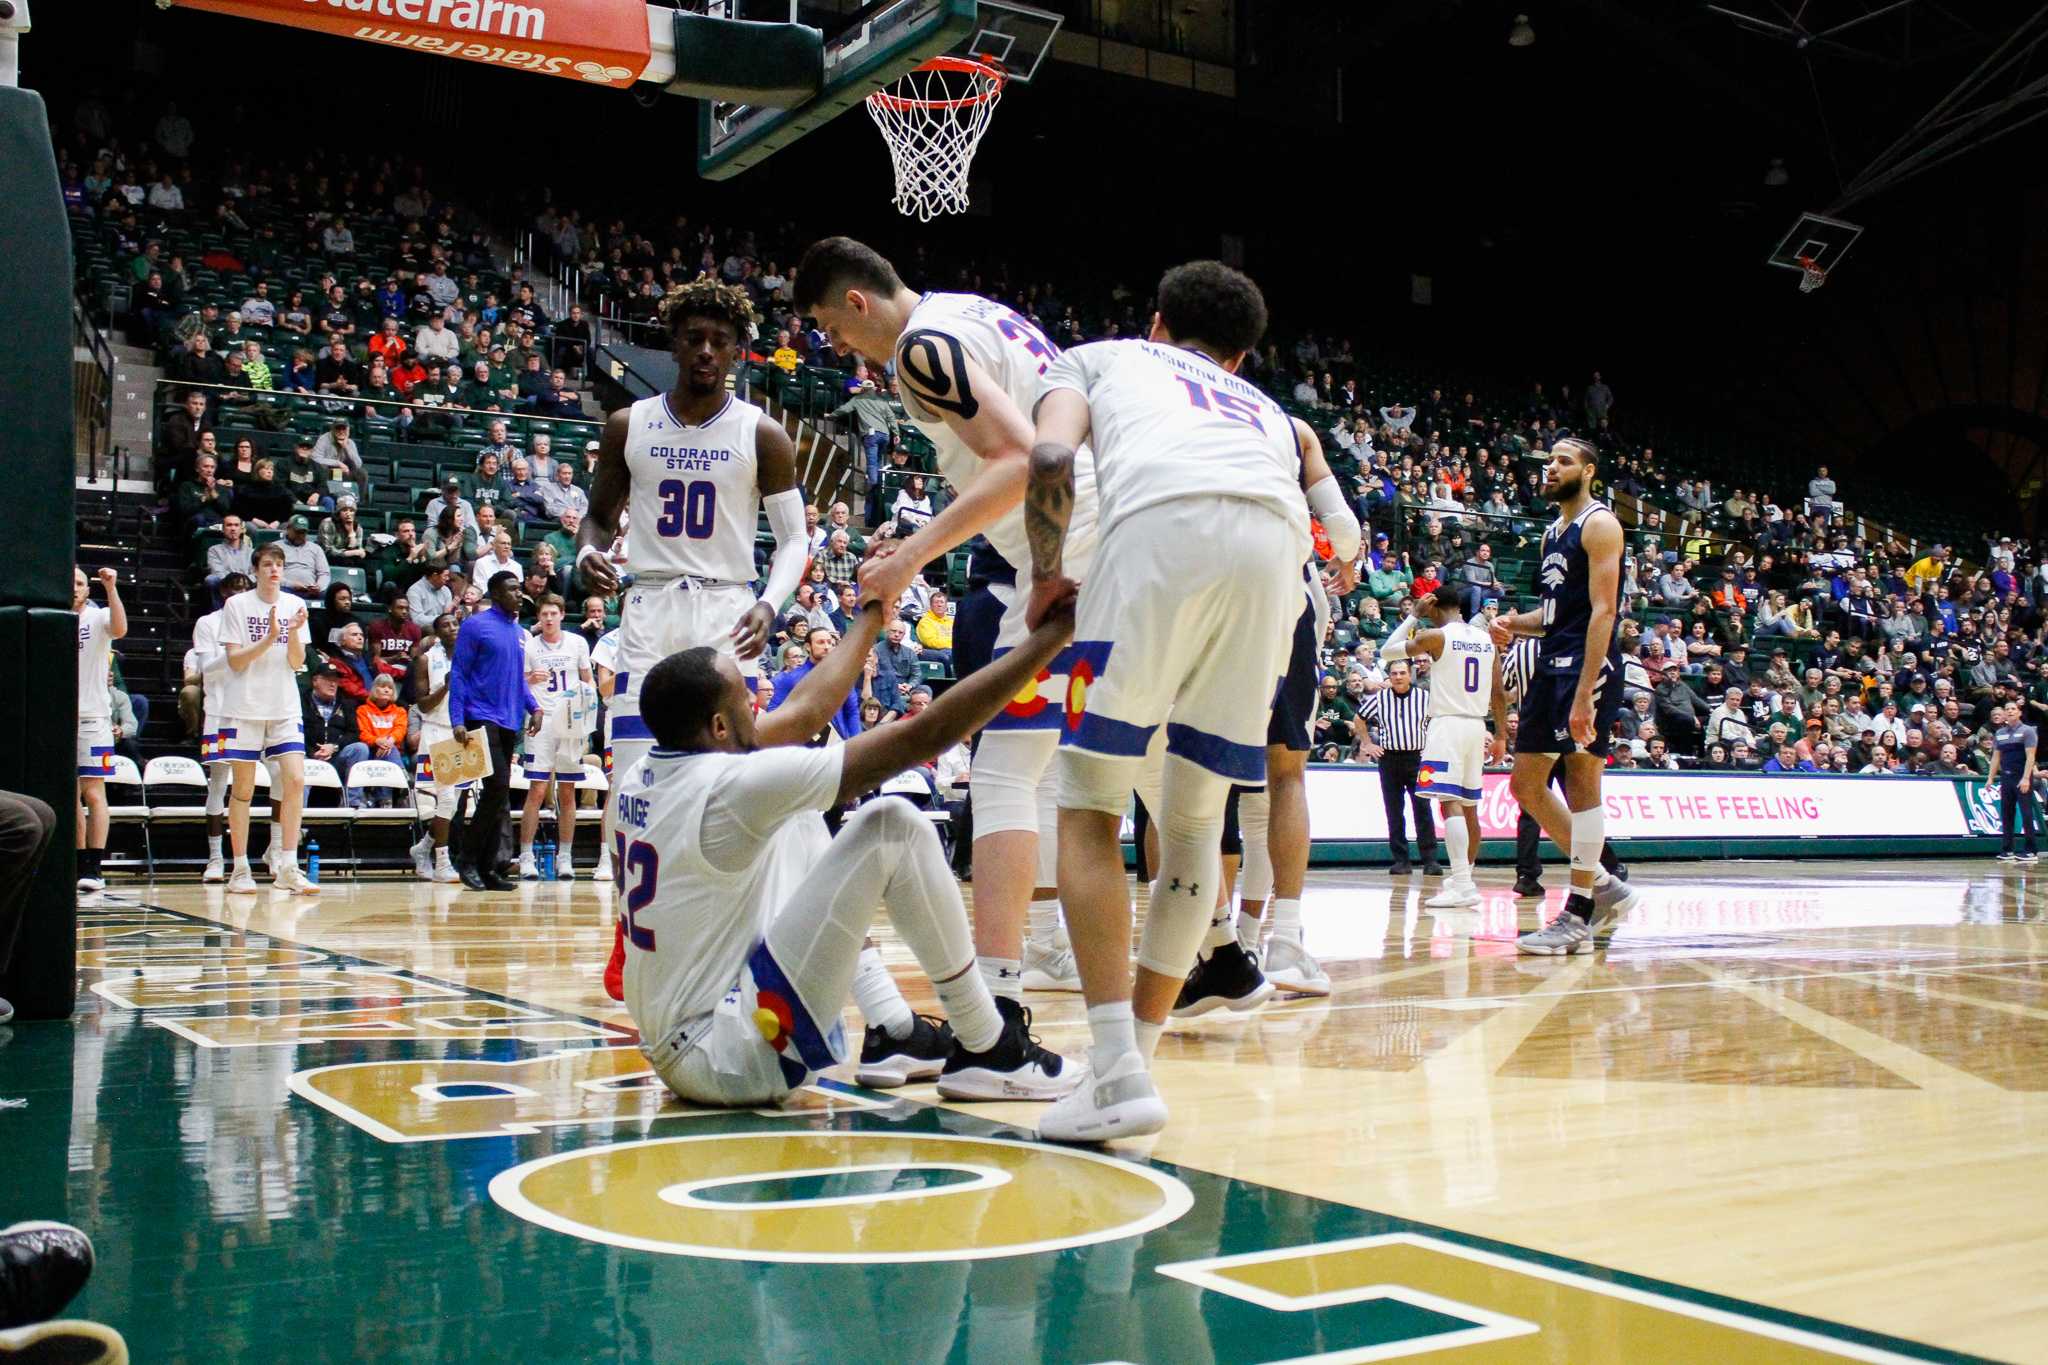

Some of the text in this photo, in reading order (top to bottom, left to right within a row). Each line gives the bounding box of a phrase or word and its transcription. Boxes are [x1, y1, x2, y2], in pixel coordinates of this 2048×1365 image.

[303, 0, 545, 40] ateFarm
[354, 26, 572, 75] StateFarm
[1174, 373, 1268, 437] 15
[650, 446, 729, 461] COLORADO
[666, 458, 711, 471] STATE
[657, 479, 716, 539] 30
[546, 669, 567, 693] 31
[1464, 656, 1479, 693] 0
[618, 793, 651, 829] PAIGE
[1603, 795, 1819, 820] STE THE FEELING
